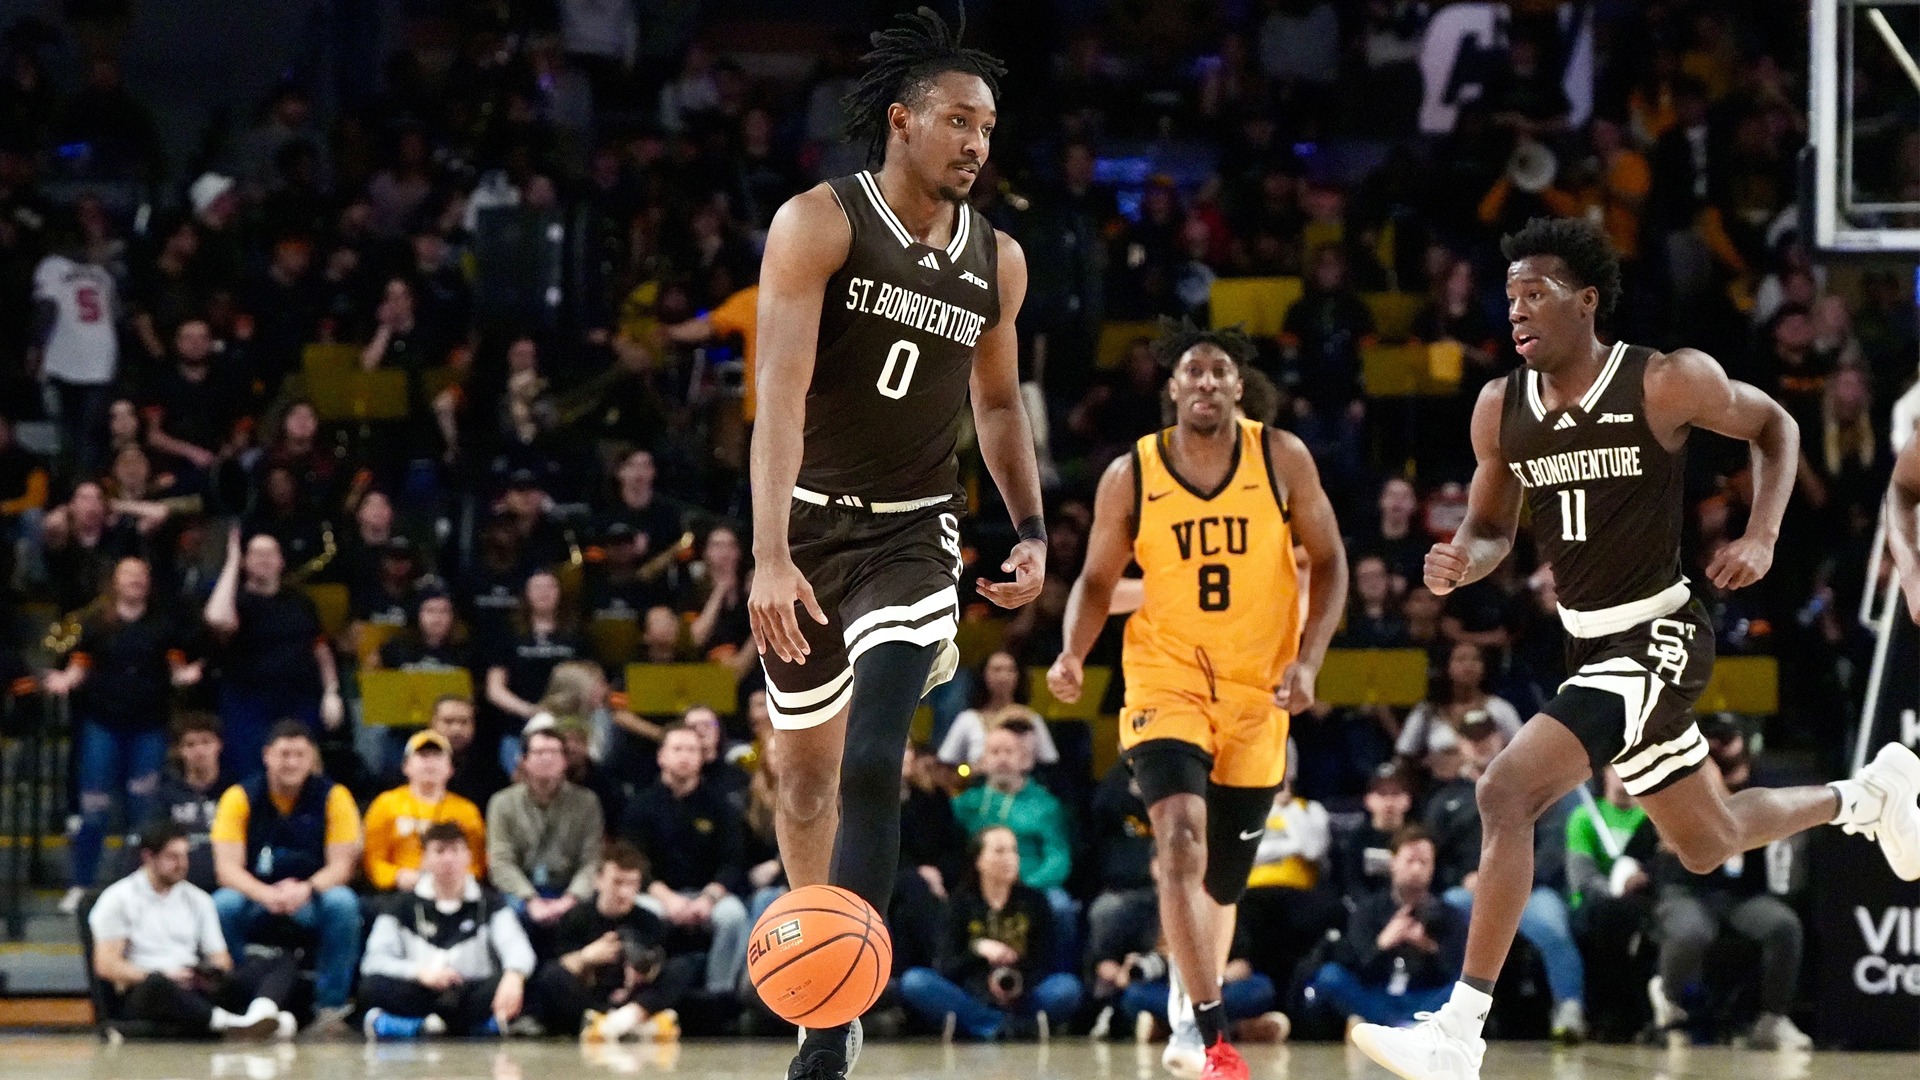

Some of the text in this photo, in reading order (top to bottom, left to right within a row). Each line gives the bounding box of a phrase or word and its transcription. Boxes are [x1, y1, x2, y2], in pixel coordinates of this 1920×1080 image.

[958, 269, 989, 290] A10
[846, 277, 986, 348] ST. BONAVENTURE
[876, 339, 920, 400] 0
[1597, 413, 1634, 424] A10
[1526, 446, 1643, 487] BONAVENTURE
[1171, 516, 1249, 560] VCU
[1557, 489, 1587, 541] 11
[1199, 564, 1230, 612] 8
